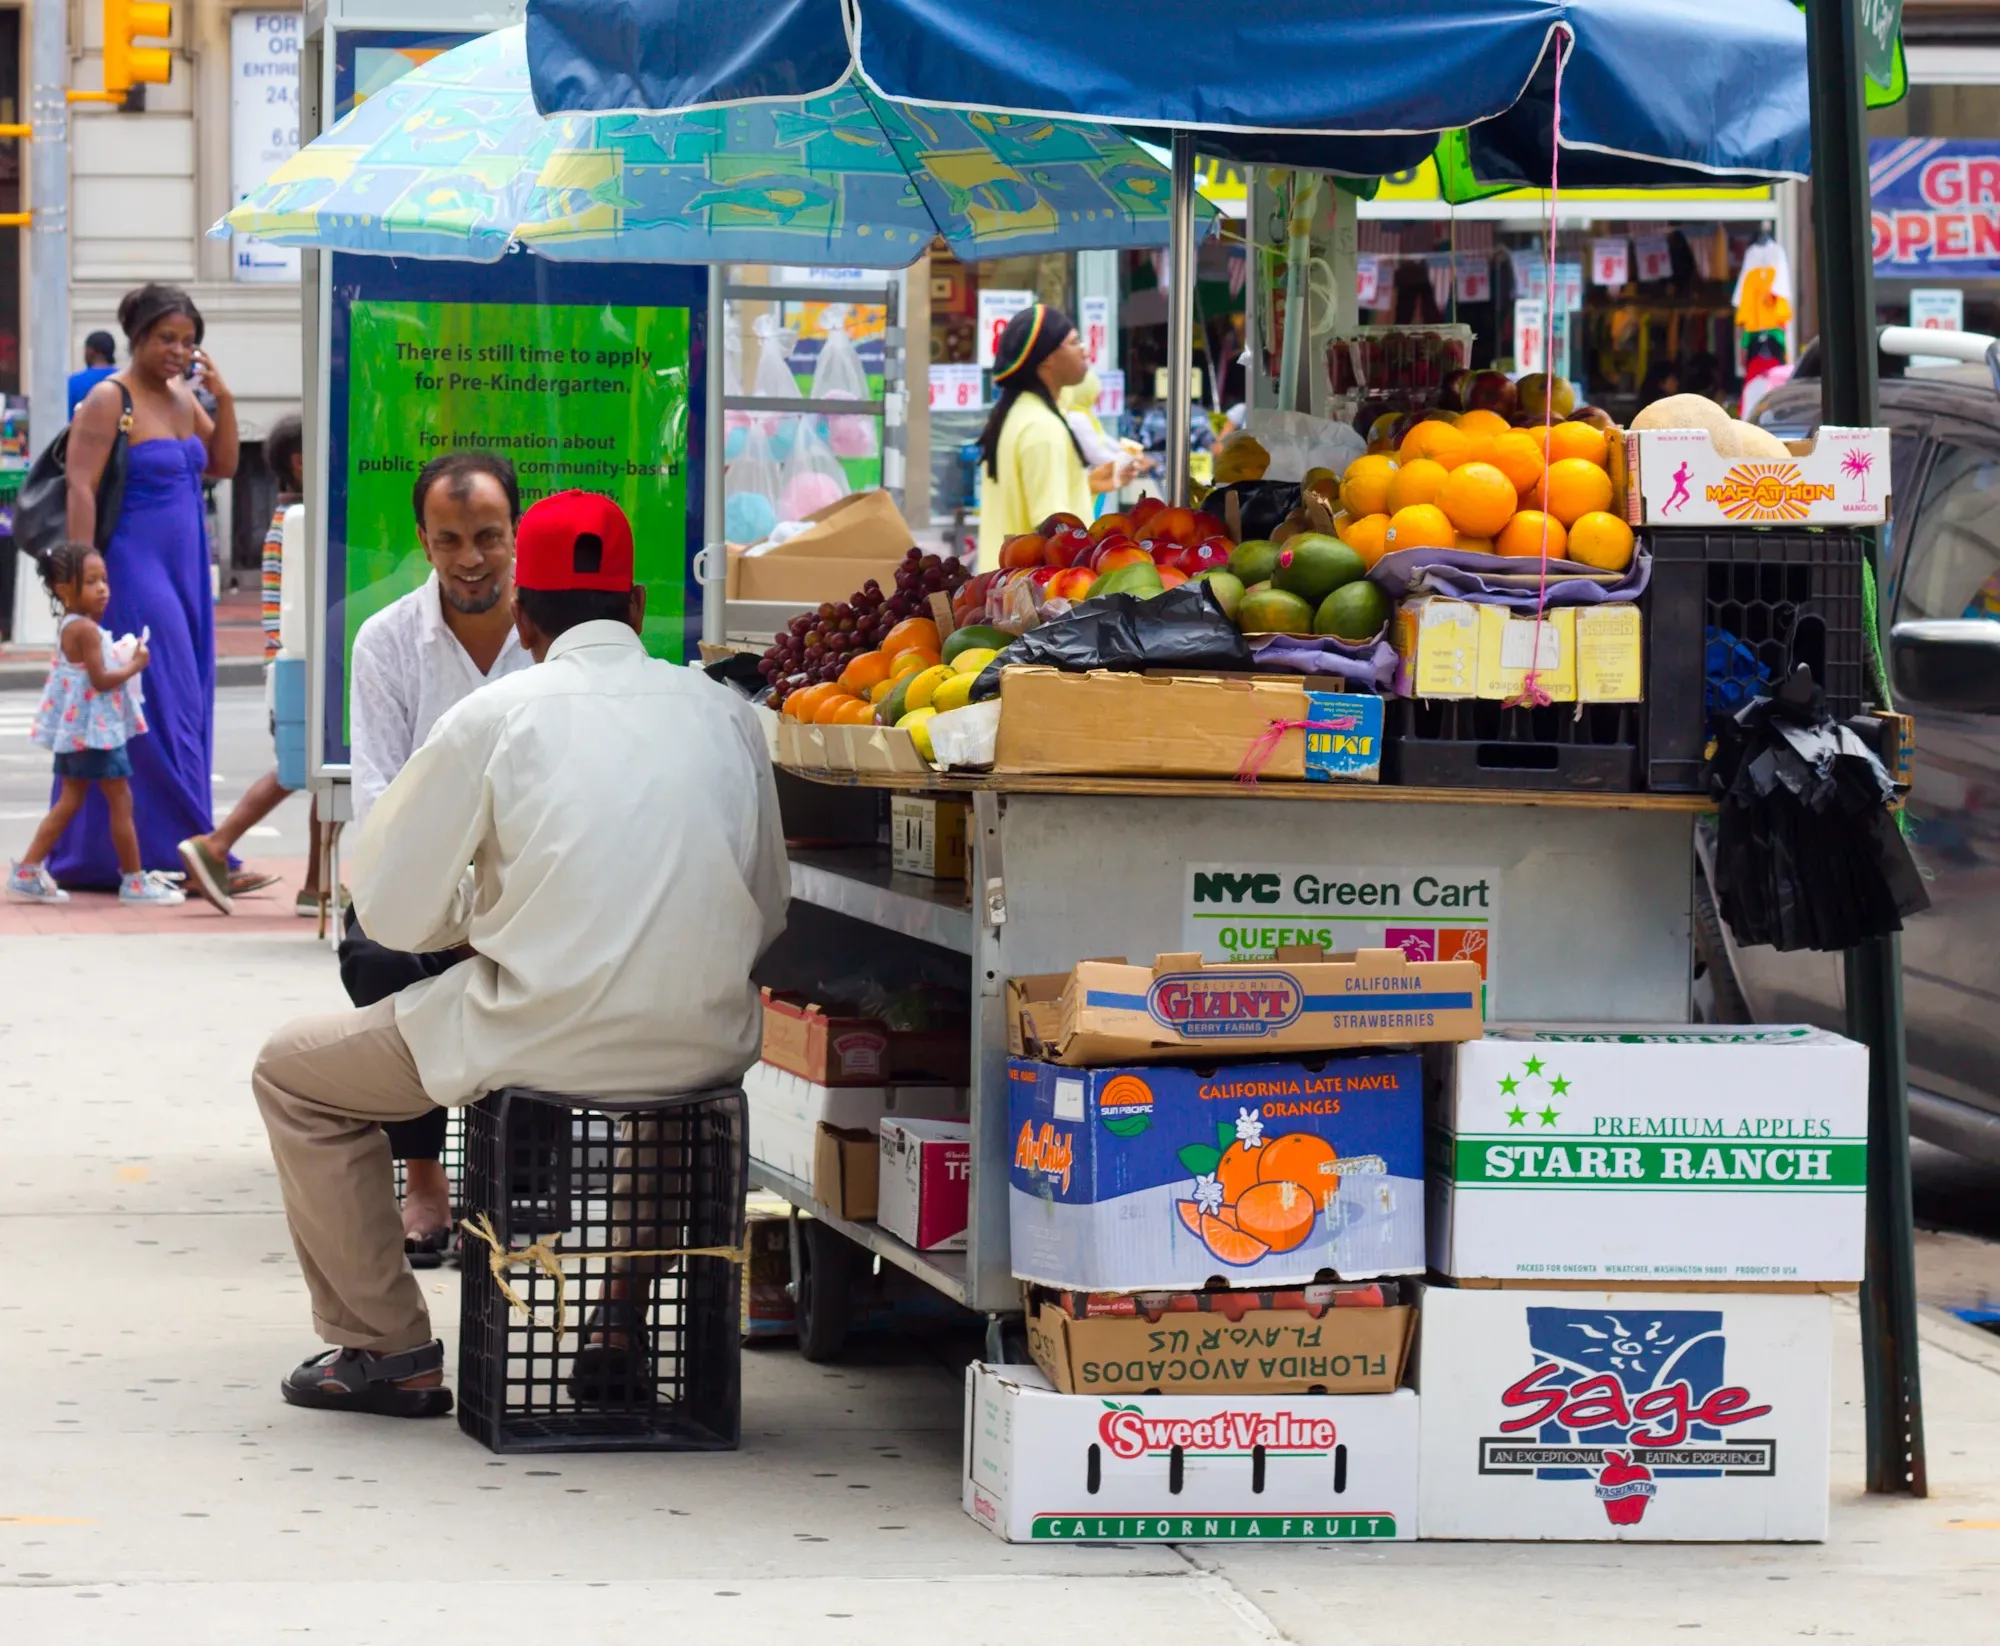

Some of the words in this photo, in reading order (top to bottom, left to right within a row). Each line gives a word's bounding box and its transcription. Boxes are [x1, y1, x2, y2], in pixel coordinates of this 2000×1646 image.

[396, 343, 451, 361] There
[457, 344, 472, 361] is
[478, 344, 514, 362] still
[520, 345, 565, 363] time
[570, 348, 590, 363] to
[596, 347, 652, 369] apply
[415, 371, 444, 390] for
[449, 374, 631, 397] Pre-Kindergarten.
[420, 431, 447, 447] For
[452, 431, 558, 449] information
[563, 434, 615, 449] about
[358, 456, 413, 476] public
[1705, 484, 1835, 501] MARATHON
[1842, 504, 1879, 512] MANGOS
[1194, 872, 1281, 904] NYC
[1293, 874, 1400, 906] Green
[1413, 876, 1489, 907] Cart
[1219, 927, 1333, 951] QUEENS
[1192, 981, 1284, 991] CALIFORNIA
[1345, 976, 1422, 992] CALIFORNIA
[1158, 983, 1290, 1020] GIANT
[1187, 1022, 1221, 1033] BERRY
[1225, 1022, 1262, 1031] FARMS
[1333, 1013, 1435, 1028] STRAWBERRIES
[1198, 1079, 1301, 1100] CALIFORNIA
[1305, 1077, 1343, 1094] LATE
[1347, 1074, 1399, 1091] NAVEL
[1263, 1099, 1341, 1118] ORANGES
[1593, 1116, 1724, 1138] PREMIUM
[1736, 1117, 1832, 1139] APPLES
[1485, 1145, 1646, 1179] STARR
[1660, 1147, 1832, 1181] RANCH
[1516, 1264, 1544, 1272] PACKED
[1546, 1264, 1561, 1272] FOR
[1563, 1264, 1597, 1273] ONEONTA
[1605, 1265, 1652, 1274] WENATCHEE,
[1654, 1265, 1703, 1274] WASHINGTON
[1736, 1266, 1769, 1275] PRODUCT
[1771, 1266, 1780, 1274] OF
[1782, 1266, 1797, 1275] USA
[1082, 1358, 1250, 1384] AVOCADOS
[1258, 1354, 1386, 1378] FLORIDA
[1499, 1363, 1773, 1447] Sage
[1495, 1452, 1514, 1463] AN
[1516, 1452, 1601, 1464] EXCEPTIONAL
[1646, 1452, 1690, 1464] EATING
[1692, 1453, 1764, 1465] EXPERIENCE
[1595, 1482, 1657, 1498] WASHINGTON
[1049, 1519, 1260, 1536] CALIFORNIA
[1281, 1519, 1380, 1536] FRUIT
